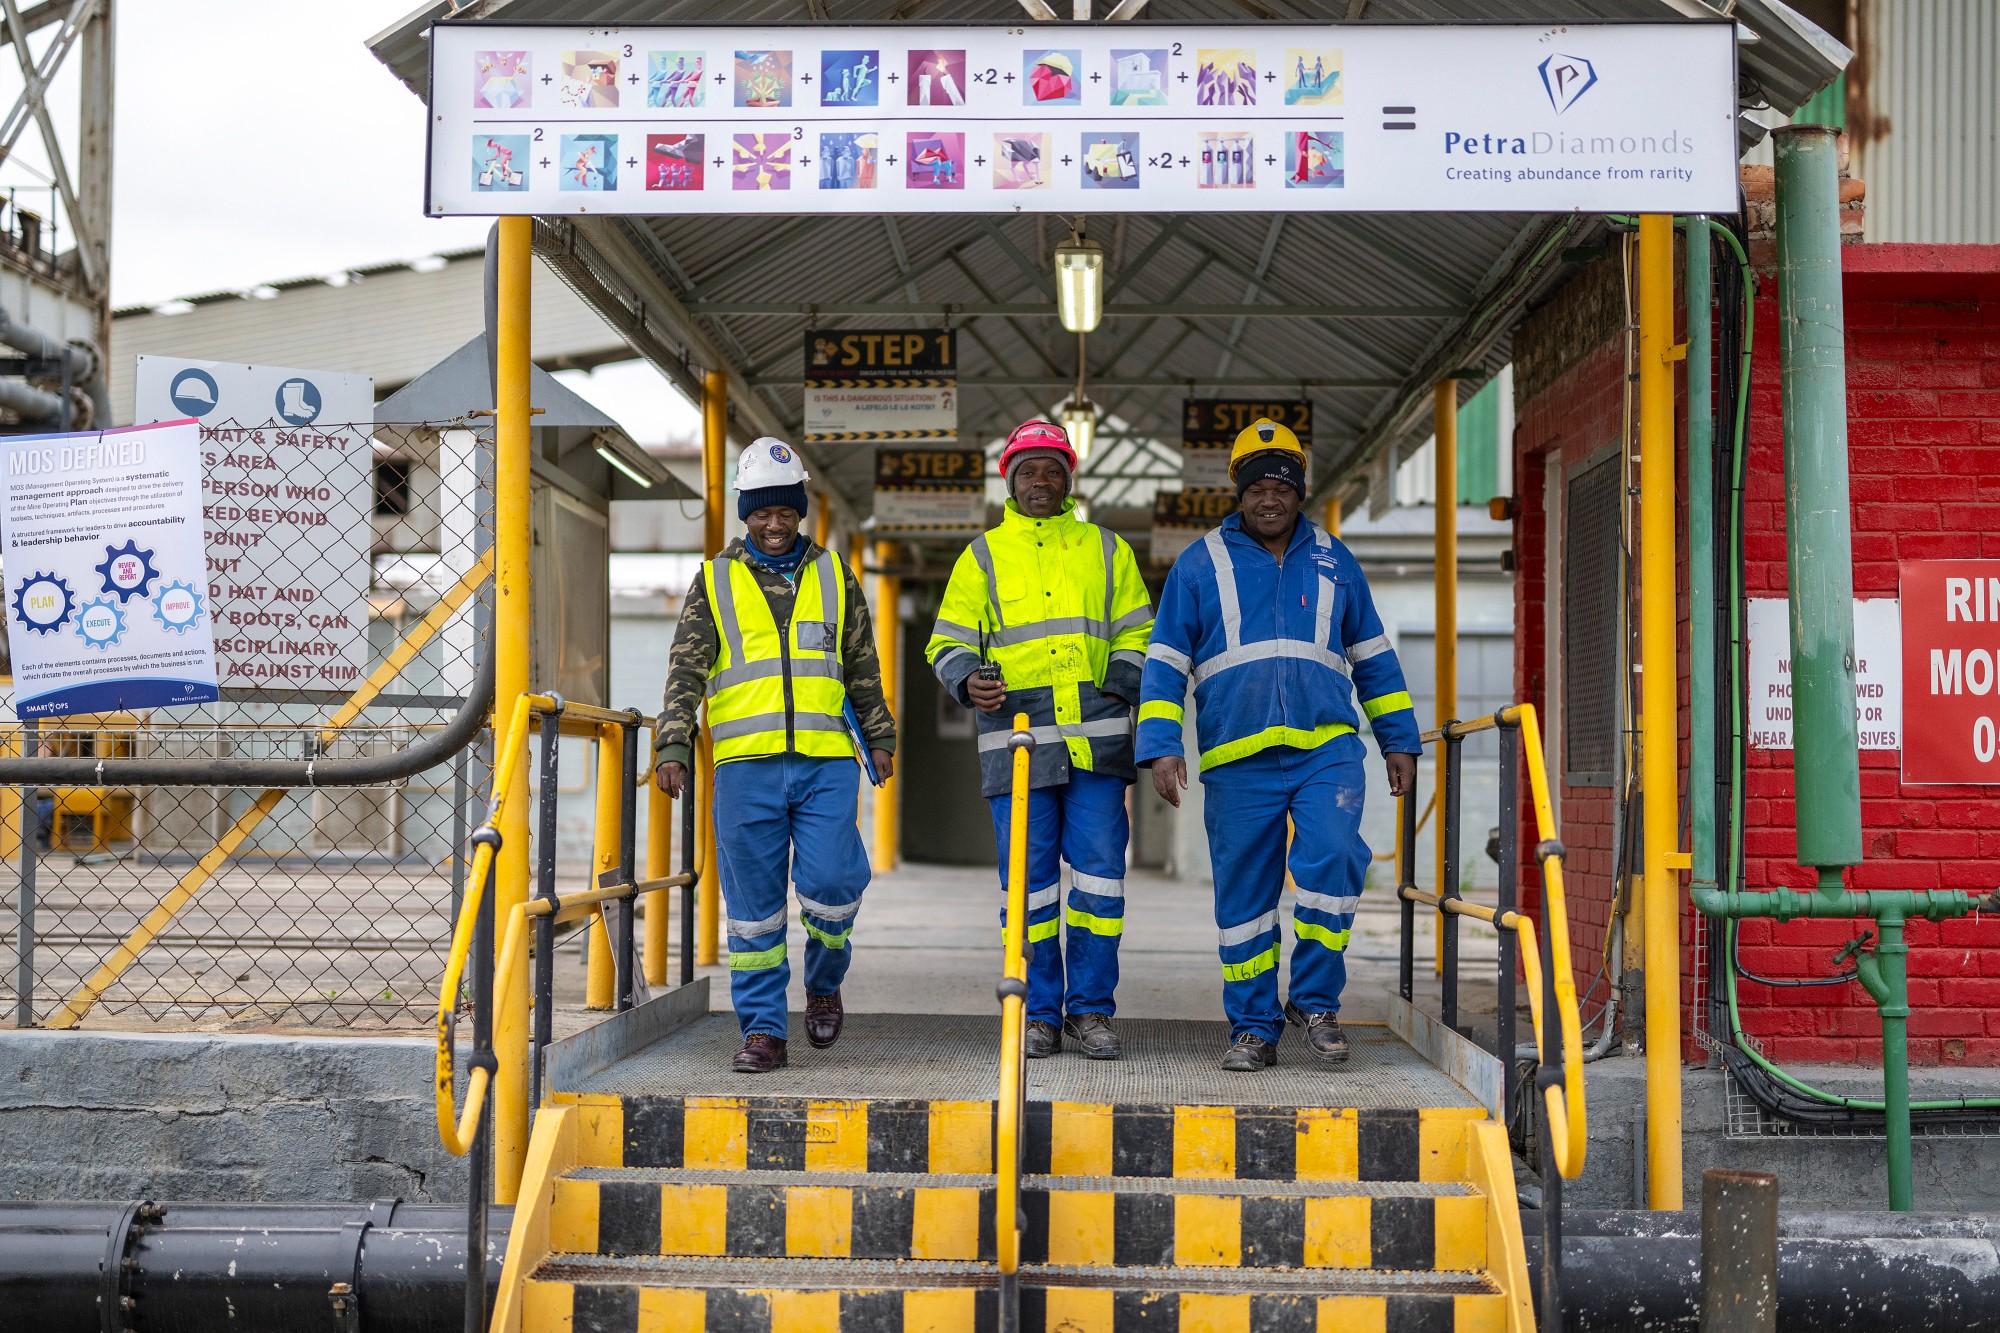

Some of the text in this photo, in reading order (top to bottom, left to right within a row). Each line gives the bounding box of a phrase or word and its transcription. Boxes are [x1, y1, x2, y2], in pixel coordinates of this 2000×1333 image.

[1446, 166, 1692, 182] Creating abundance from rarity
[841, 334, 950, 366] STEP 1
[1214, 404, 1310, 431] STEP 2
[254, 430, 266, 444] &
[275, 432, 350, 450] SAFETY
[9, 440, 145, 476] MOS DEFINED
[223, 454, 277, 470] AREA
[902, 452, 984, 477] STEP 3
[64, 478, 91, 488] Operating
[126, 470, 170, 481] systematic
[10, 490, 64, 501] management
[66, 487, 104, 497] approach
[104, 484, 130, 493] designed
[162, 480, 184, 489] delivery
[202, 480, 330, 501] PERSON WHO
[42, 501, 68, 510] Operating
[70, 498, 88, 506] Plan
[89, 496, 116, 505] objectives
[118, 494, 140, 502] through
[1176, 496, 1232, 516] STEP
[46, 527, 76, 535] framework
[128, 516, 185, 528] accountability
[248, 508, 328, 526] BEYOND
[20, 536, 62, 546] leadership
[204, 530, 262, 547] POINT
[30, 596, 54, 609] PLAN
[228, 585, 268, 600] HAT
[274, 588, 314, 602] AND
[166, 602, 190, 610] IMPROVE
[86, 619, 110, 628] EXECUTE
[230, 612, 302, 630] BOOTS,
[308, 614, 348, 629] CAN
[82, 657, 106, 666] contains
[140, 652, 171, 660] documents
[42, 671, 62, 679] dictate
[94, 666, 123, 675] processes
[160, 660, 186, 668] business
[227, 662, 314, 678] AGAINST
[322, 666, 356, 680] HIM
[1930, 648, 2000, 696] MO
[26, 704, 48, 712] SMART
[1865, 707, 1882, 721] OR
[1754, 732, 1786, 746] NEAR
[1858, 732, 1896, 746] SIVES
[1973, 716, 2000, 762] 0
